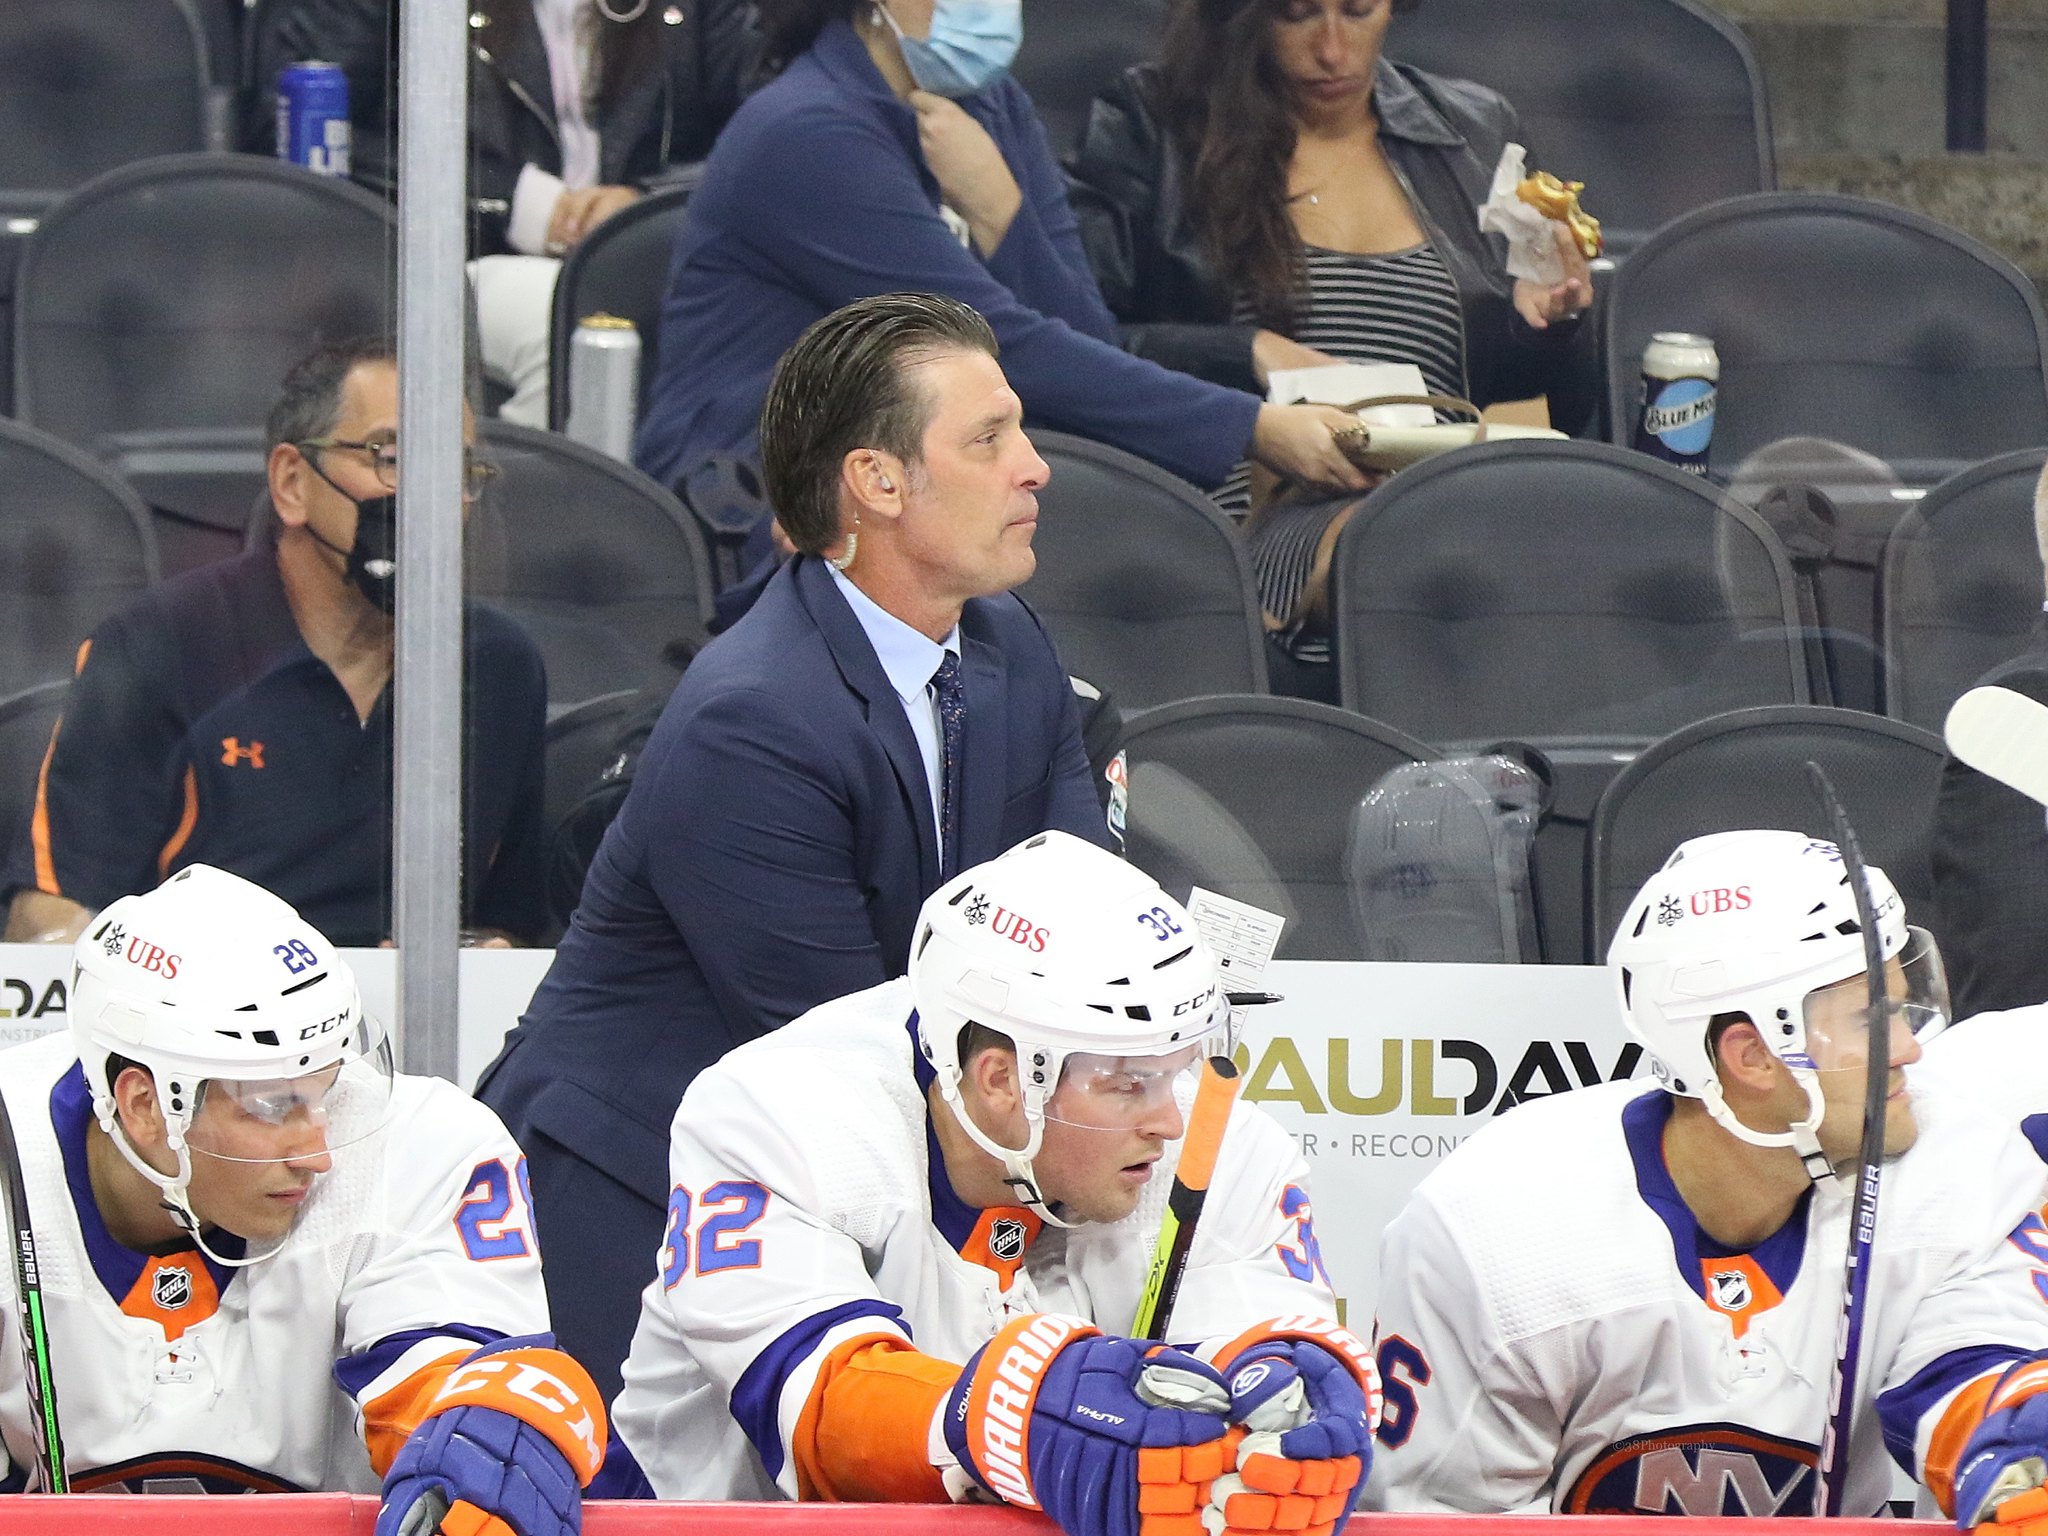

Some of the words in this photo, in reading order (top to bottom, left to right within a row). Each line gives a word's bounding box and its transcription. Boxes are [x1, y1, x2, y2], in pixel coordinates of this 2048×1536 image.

[1689, 885, 1753, 916] UBS
[991, 906, 1050, 953] UBS
[1137, 906, 1184, 942] 32
[126, 936, 183, 980] UBS
[273, 938, 318, 975] 28
[1173, 984, 1216, 1016] CCM
[299, 1007, 350, 1041] CCM
[1351, 1134, 1471, 1158] RECON
[453, 1157, 542, 1263] 2
[1857, 1163, 1881, 1244] BAUER
[20, 1229, 38, 1285] BAUER
[997, 1231, 1019, 1250] NHL
[160, 1278, 185, 1301] NHL
[1371, 1310, 1432, 1450] 6
[434, 1360, 601, 1470] CCM
[957, 1376, 976, 1423] JOHN
[1076, 1404, 1126, 1425] ALPHA
